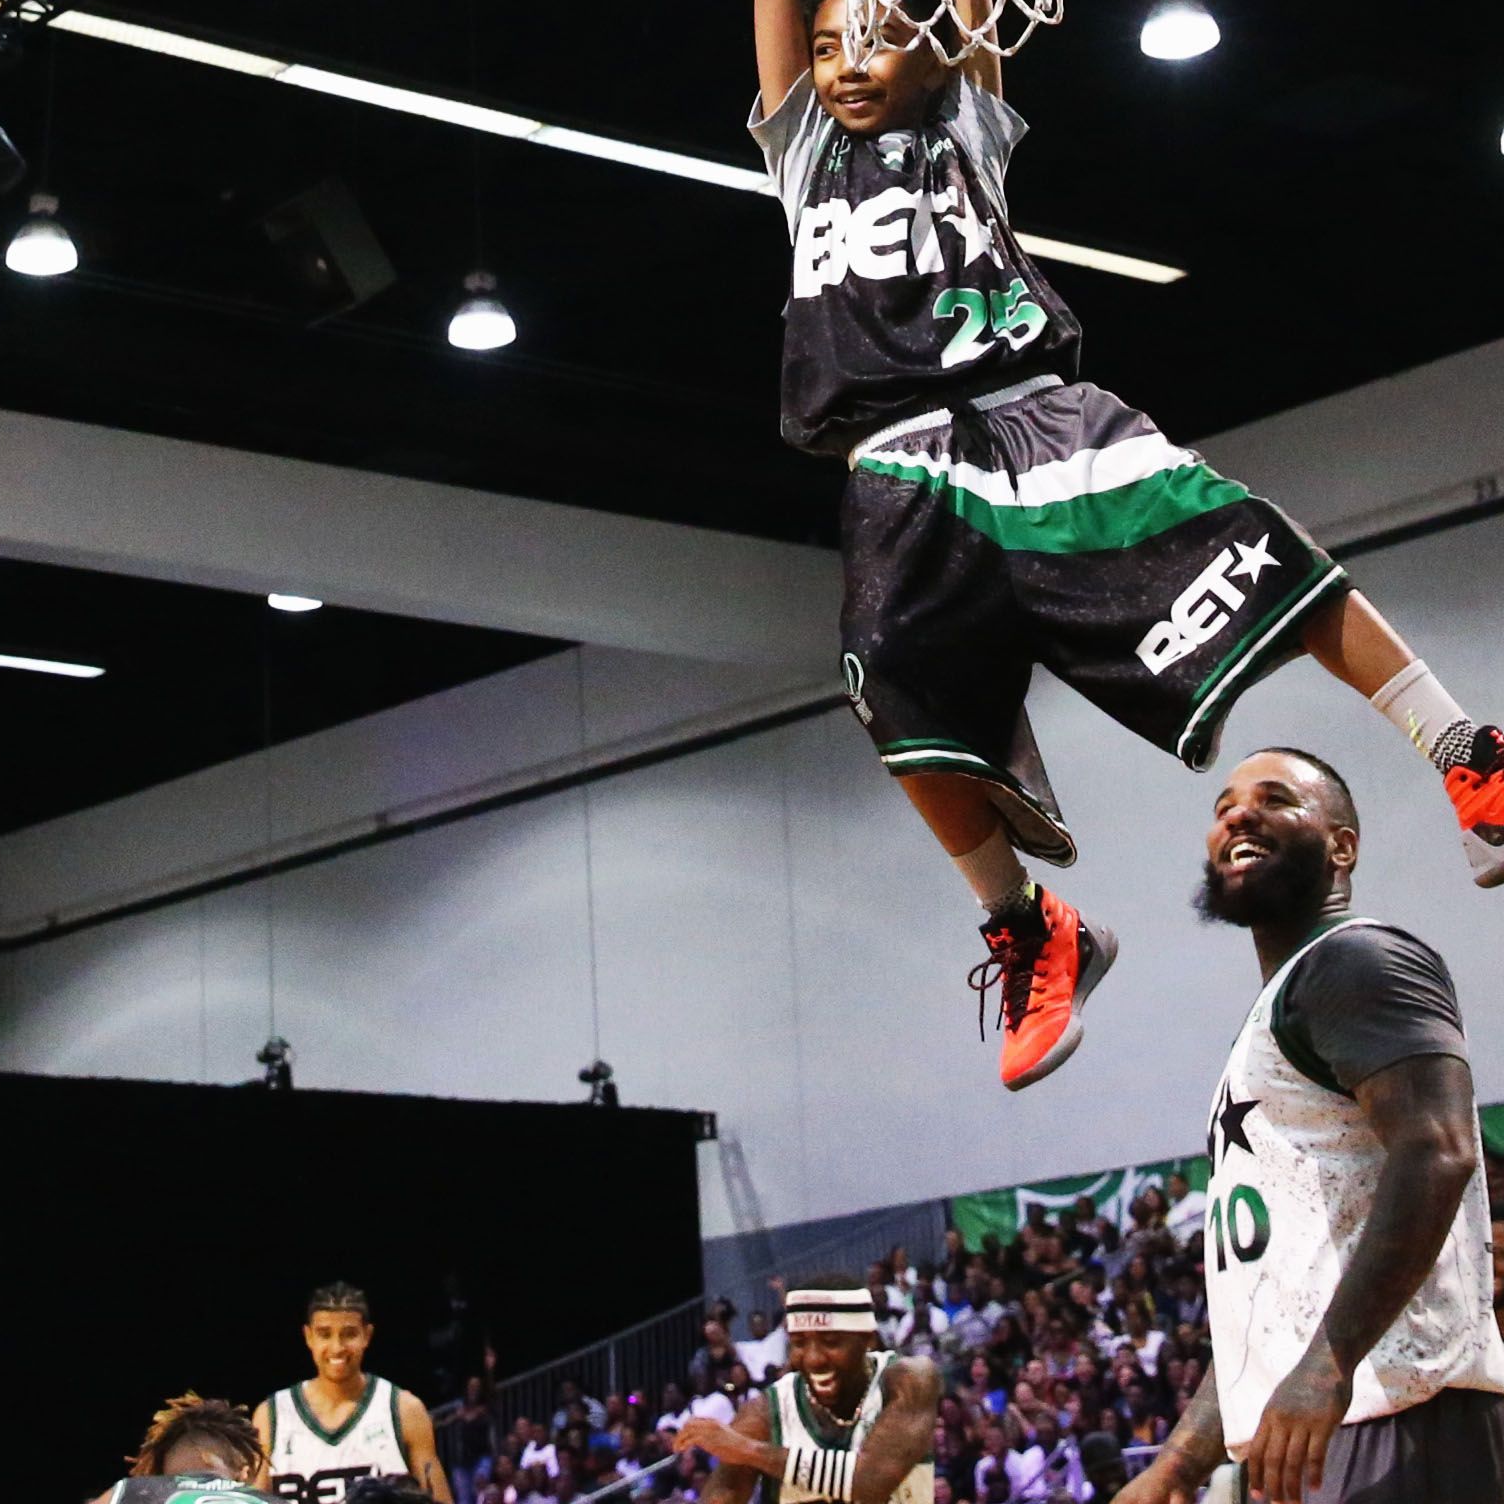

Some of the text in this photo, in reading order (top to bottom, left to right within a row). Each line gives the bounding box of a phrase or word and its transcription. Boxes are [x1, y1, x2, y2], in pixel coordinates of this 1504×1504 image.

[793, 185, 959, 299] BET
[932, 278, 1048, 369] 25
[1134, 547, 1246, 676] BET
[1209, 1184, 1271, 1272] 10
